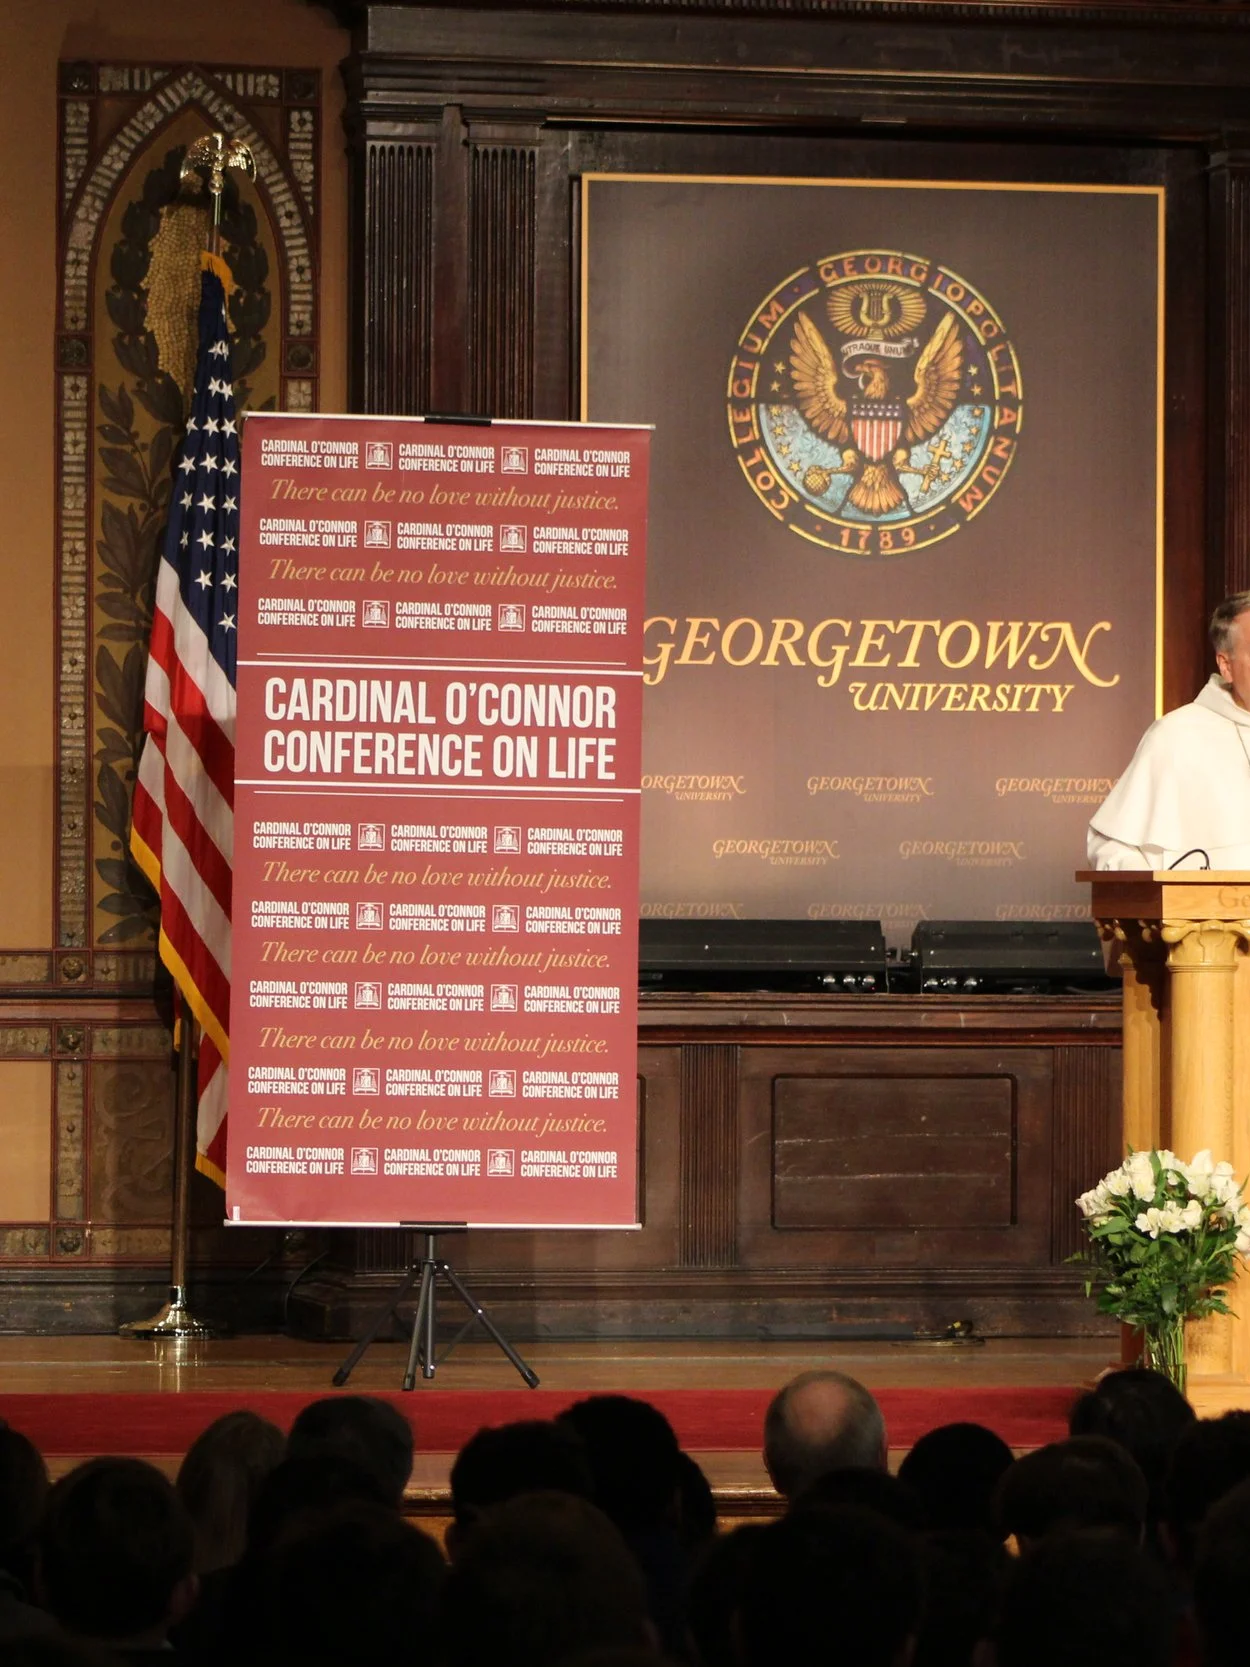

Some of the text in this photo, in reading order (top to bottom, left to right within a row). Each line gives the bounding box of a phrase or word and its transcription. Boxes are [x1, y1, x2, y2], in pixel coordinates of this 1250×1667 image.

[261, 439, 359, 454] CARDINAL O'CONNOR
[399, 443, 495, 458] CARDINAL O'CONNOR
[261, 453, 359, 468] CONFERENCE ON LIFE
[534, 448, 631, 463] CARDINAL O'CONNOR
[398, 457, 495, 472] CONFERENCE ON LIFE
[534, 462, 630, 477] CONFERENCE ON LIFE
[270, 479, 619, 516] There can be no love without justice.
[840, 527, 916, 550] 1789
[643, 616, 1120, 688] GEORGETOWN
[264, 677, 616, 728] CARDINAL O'CONNOR
[848, 682, 1075, 713] UNIVERSITY
[263, 729, 615, 779] CONFERENCE ON LIFE
[641, 775, 747, 794] ORGETOWN
[807, 776, 935, 796] GEORGETOWN
[674, 791, 734, 801] UNIVERSITY
[253, 821, 352, 835] CARDINAL O'CONNOR
[391, 824, 488, 838] CARDINAL O'CONNOR
[527, 827, 624, 841] CARDINAL O'CONNOR
[253, 835, 351, 849] CONFERENCE ON LIFE
[391, 839, 488, 853] CONFERENCE ON LIFE
[527, 842, 624, 855] CONFERENCE ON LIFE
[712, 839, 841, 860] GEORGETOWN
[899, 840, 1027, 860] GEORGETOWN
[262, 861, 612, 895] There can be no love without justice.
[640, 902, 745, 919] ORGETOWN
[807, 902, 933, 920] GEORGETOWN
[995, 903, 1092, 920] GEORGETO
[257, 1107, 608, 1139] There can be no love without justice.
[246, 1146, 345, 1160] CARDINAL O'CONNOR
[385, 1148, 482, 1162] CARDINAL O'CONNOR
[521, 1150, 618, 1164] CARDINAL O'CONNOR
[246, 1161, 345, 1174] CONFERENCE ON LIFE
[384, 1162, 482, 1176] CONFERENCE ON LIFE
[521, 1164, 618, 1177] CONFERENCE ON LIFE
